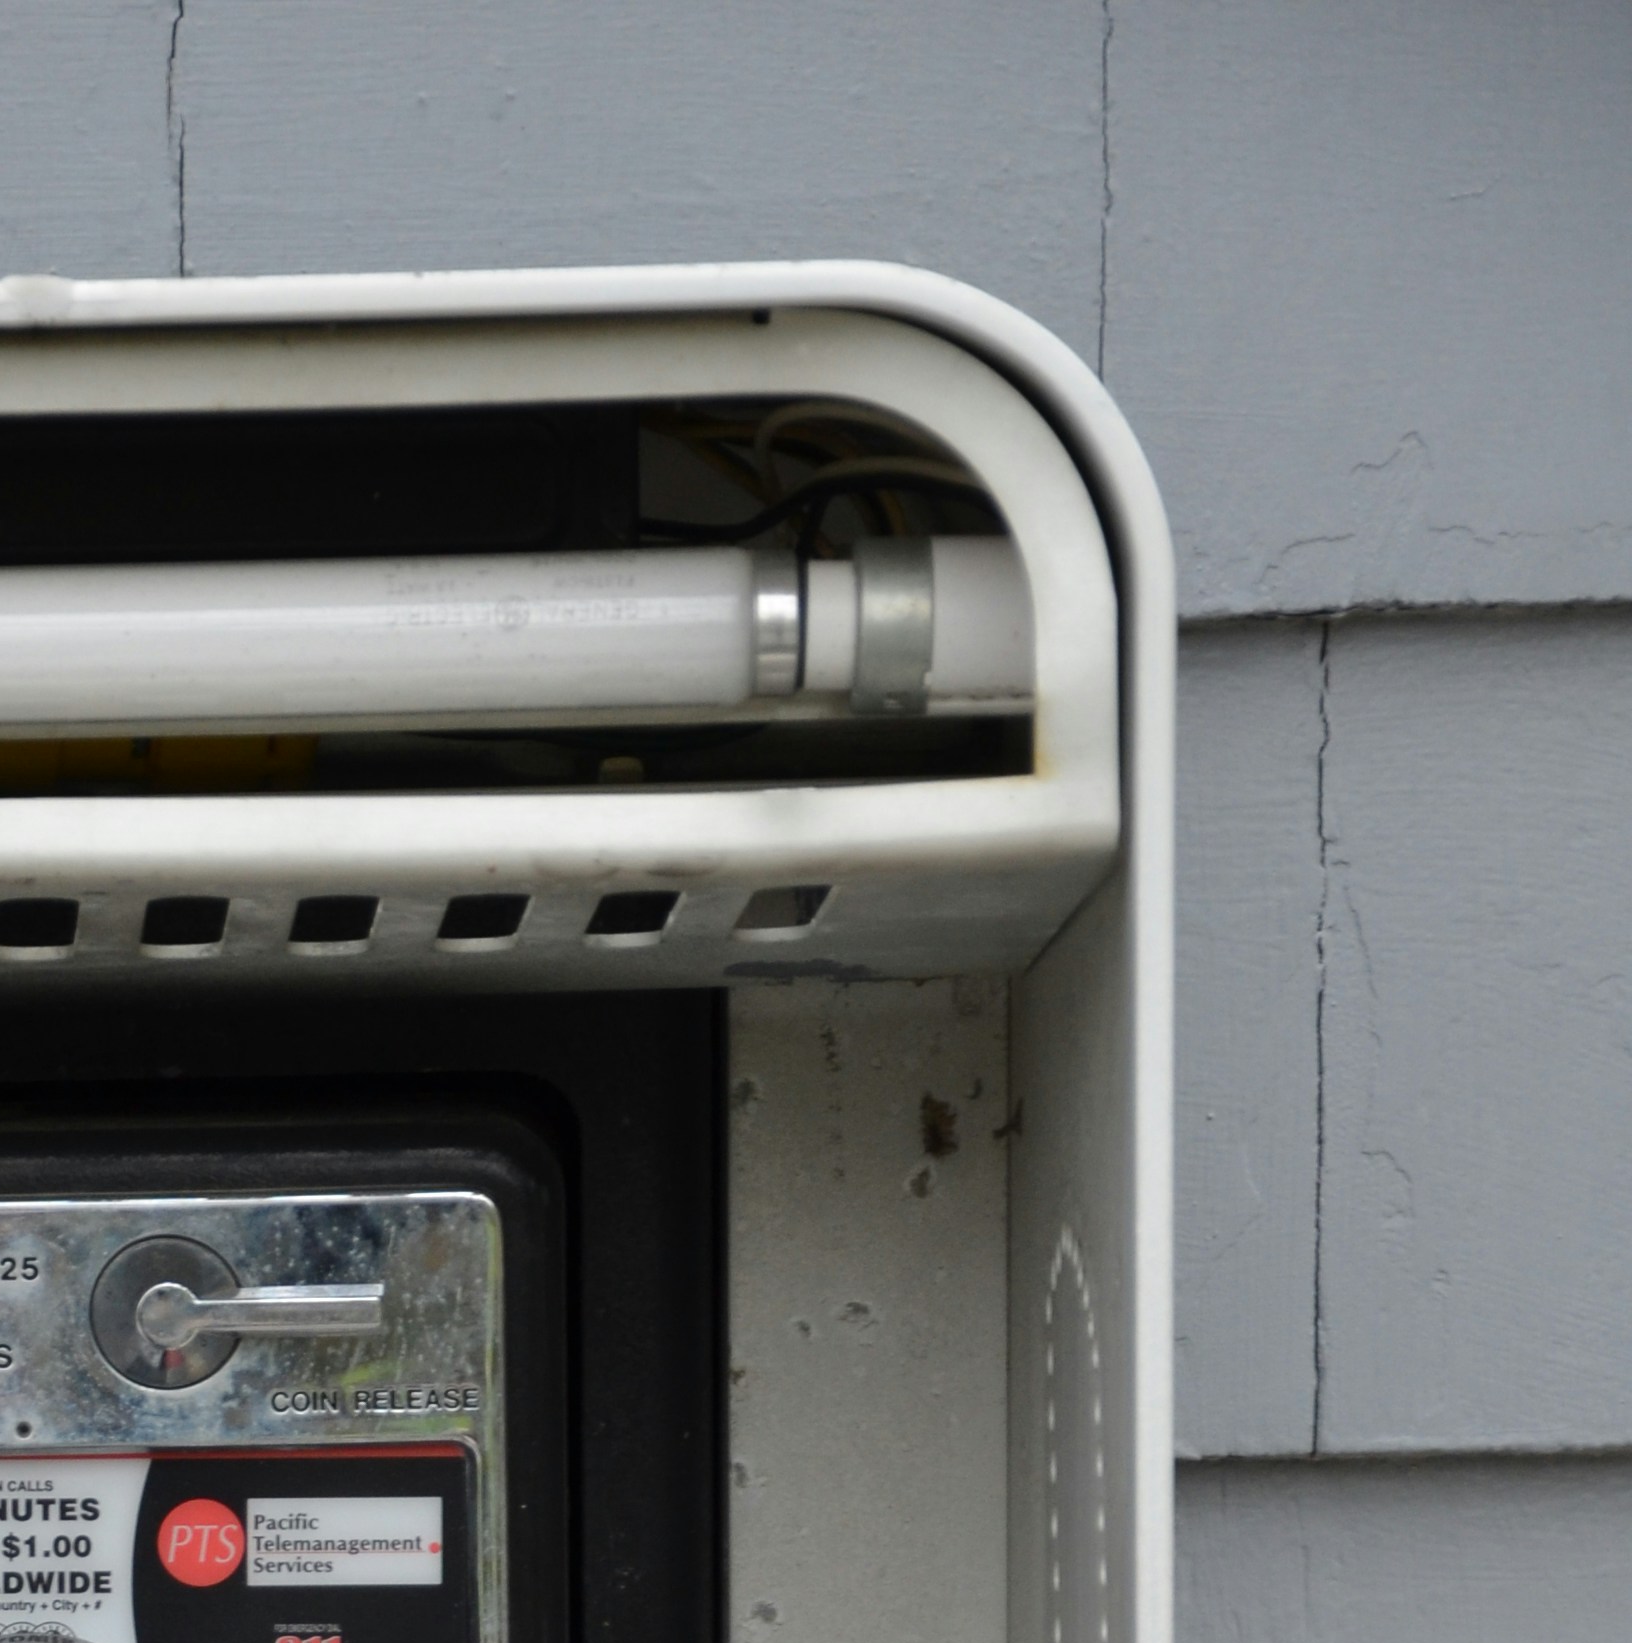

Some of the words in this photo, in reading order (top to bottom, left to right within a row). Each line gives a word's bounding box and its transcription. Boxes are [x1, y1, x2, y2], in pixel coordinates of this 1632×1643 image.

[271, 1390, 339, 1413] COIN
[353, 1388, 480, 1412] RELEASE
[7, 1479, 54, 1492] CALLS
[253, 1513, 319, 1530] Pacific
[2, 1532, 92, 1563] $1.00
[168, 1524, 237, 1564] PTS
[253, 1535, 422, 1555] Telemanagement
[253, 1556, 334, 1574] Services
[52, 1599, 78, 1614] City
[94, 1600, 102, 1611] #
